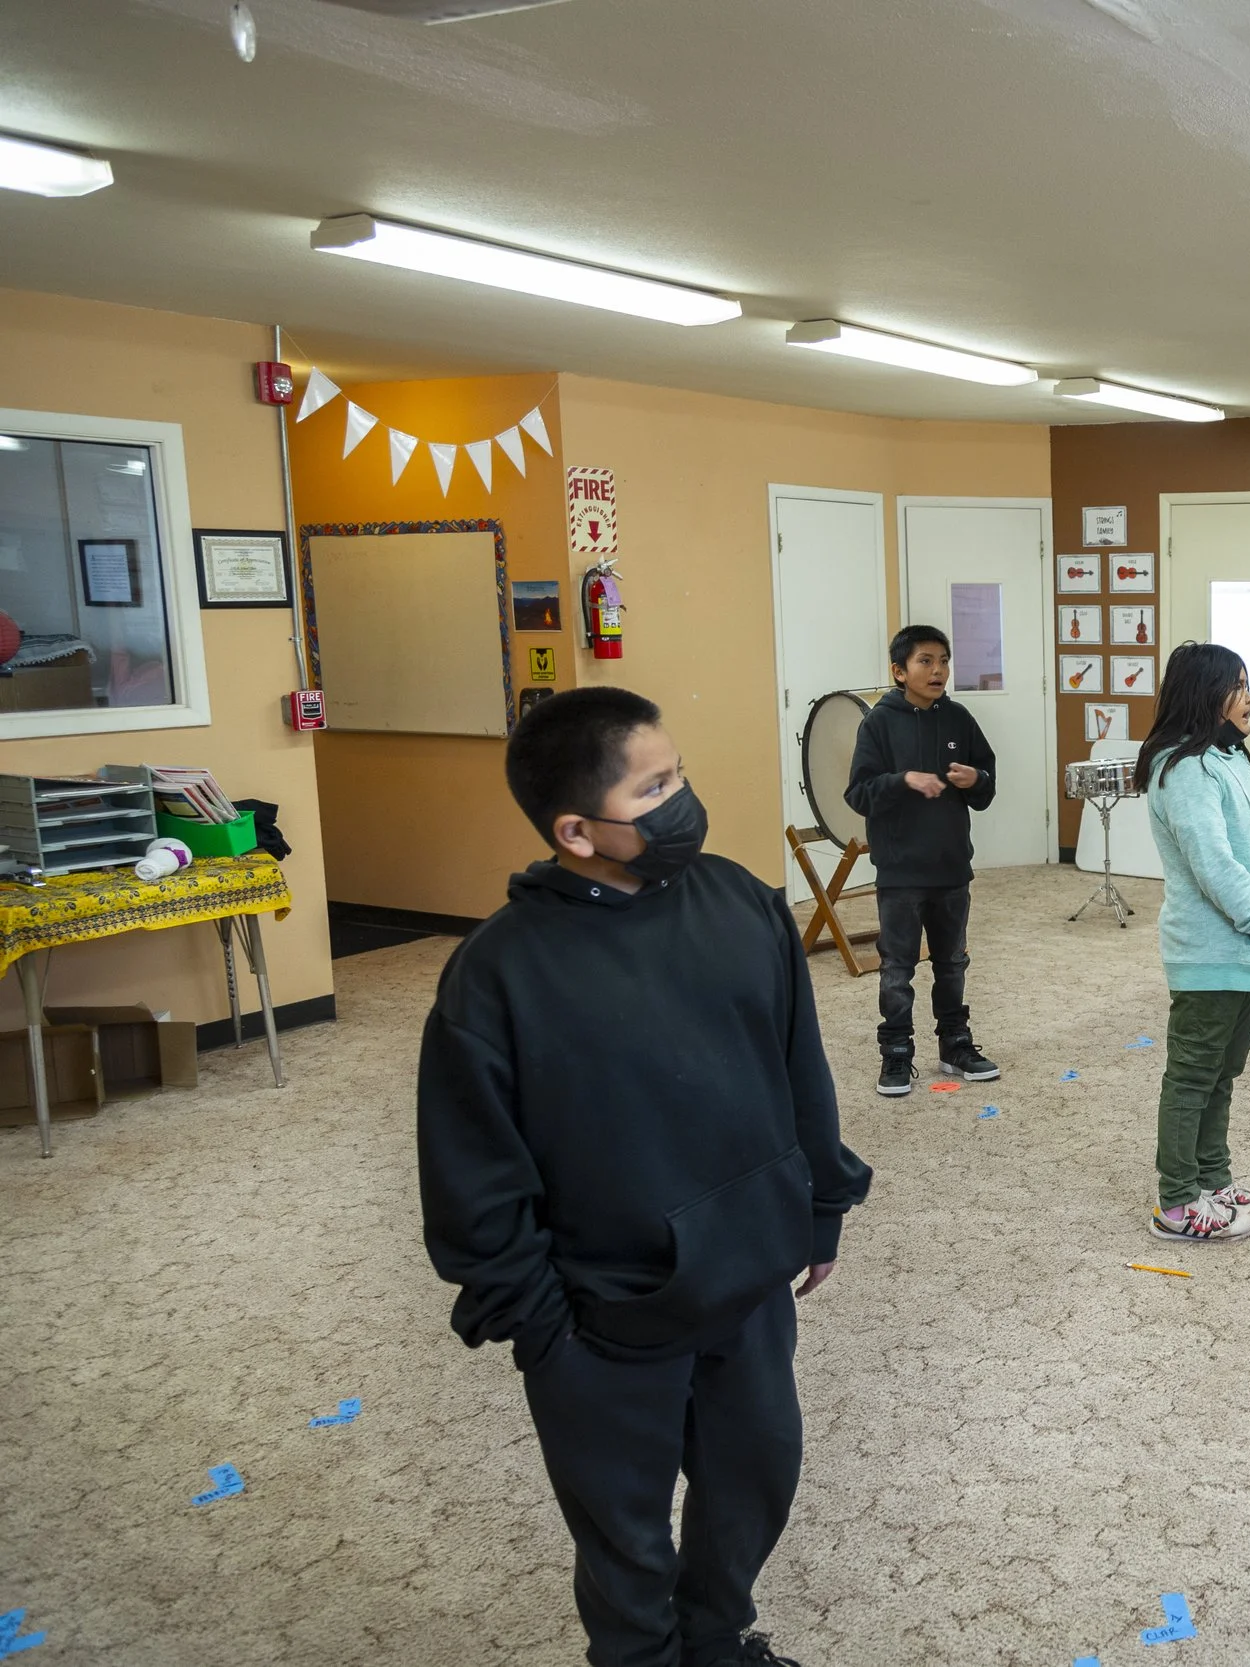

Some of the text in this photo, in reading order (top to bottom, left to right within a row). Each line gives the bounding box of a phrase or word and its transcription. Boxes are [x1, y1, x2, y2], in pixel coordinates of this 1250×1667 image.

[573, 477, 610, 501] FIRE
[576, 505, 611, 528] EXTINGUISHER
[300, 692, 321, 701] FIRE
